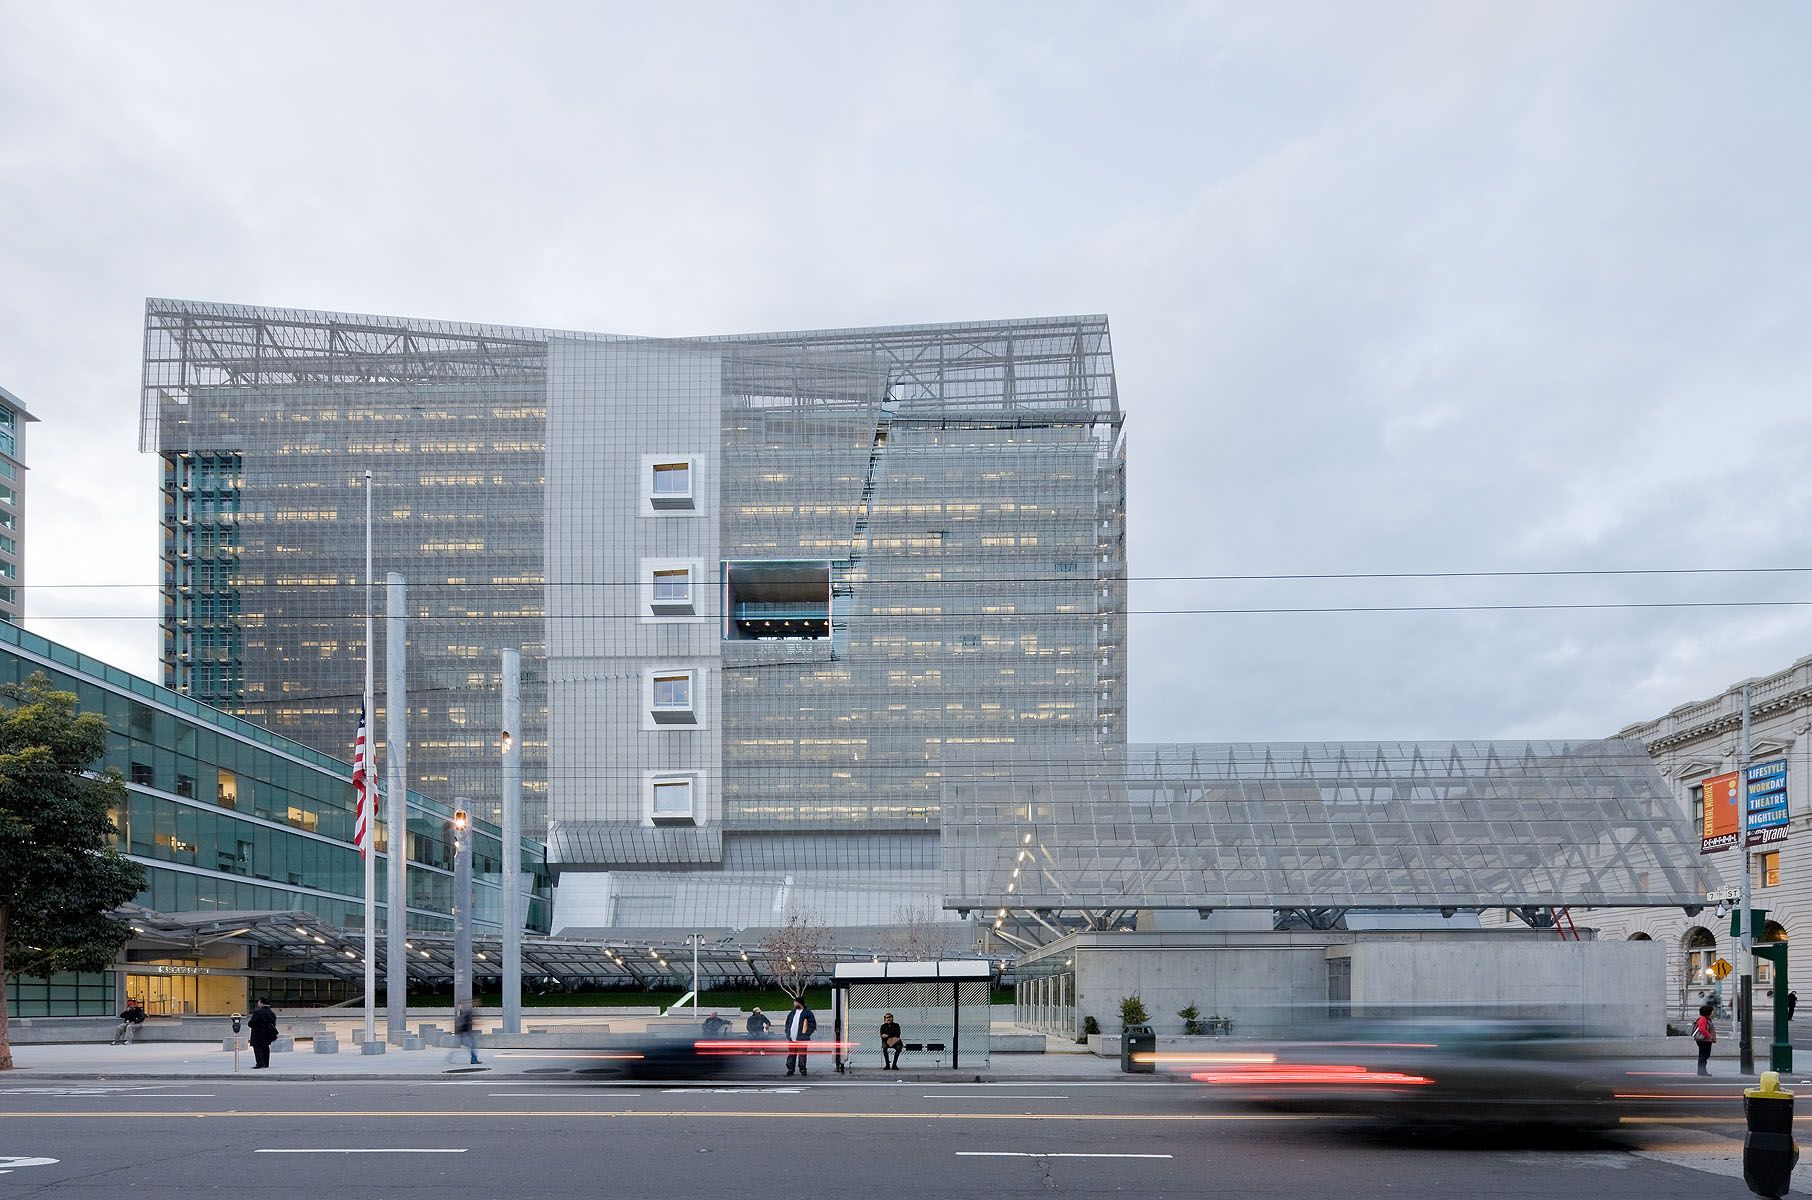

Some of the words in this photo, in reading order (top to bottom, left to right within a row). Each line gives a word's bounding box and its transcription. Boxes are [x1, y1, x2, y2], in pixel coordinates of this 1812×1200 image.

[1749, 762, 1785, 778] LIFESTYLE
[1749, 777, 1785, 794] WORKDAY
[1750, 794, 1785, 809] THEATRE
[1704, 807, 1714, 836] CENTRAL
[1748, 809, 1787, 825] NIGHTLIFE
[1762, 825, 1790, 843] grand
